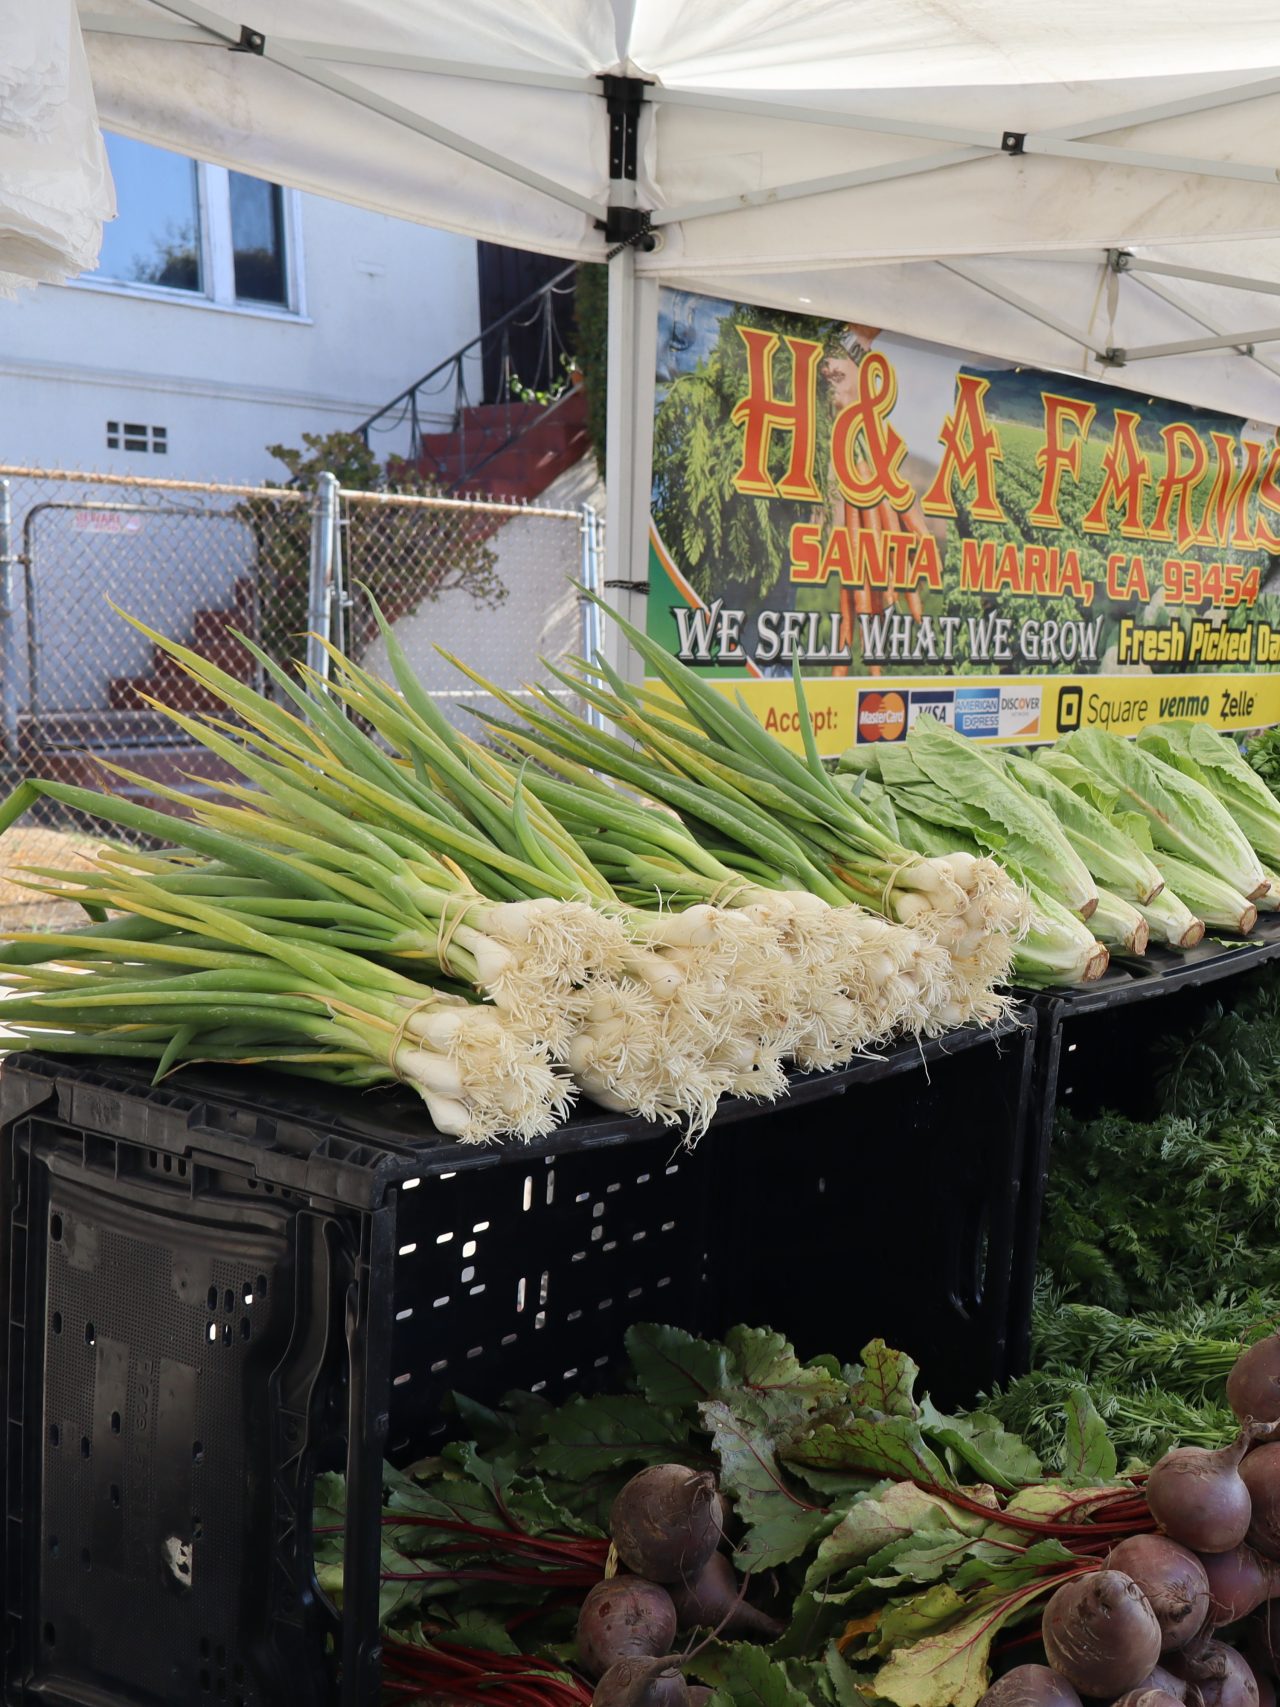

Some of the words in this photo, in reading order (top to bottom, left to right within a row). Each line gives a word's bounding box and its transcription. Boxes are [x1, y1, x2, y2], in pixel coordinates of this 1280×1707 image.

[789, 522, 944, 591] SANTA
[958, 538, 1095, 608] MARIA,
[1106, 553, 1151, 602] CA
[1162, 559, 1262, 608] 93454
[672, 597, 747, 660] WE
[754, 610, 852, 661] SELL
[858, 604, 962, 661] WHAT
[967, 608, 1014, 661] WE
[1020, 614, 1104, 663] GROW
[1119, 617, 1186, 662] Fresh
[1188, 621, 1253, 662] Picked
[859, 710, 905, 725] MasterCard
[955, 698, 999, 713] AMERICAN
[1001, 697, 1040, 710] DISCOVER
[1086, 693, 1149, 730] Square
[1159, 695, 1210, 718] venmo
[1219, 688, 1255, 721] Zelle
[963, 714, 1000, 730] EXPRESS
